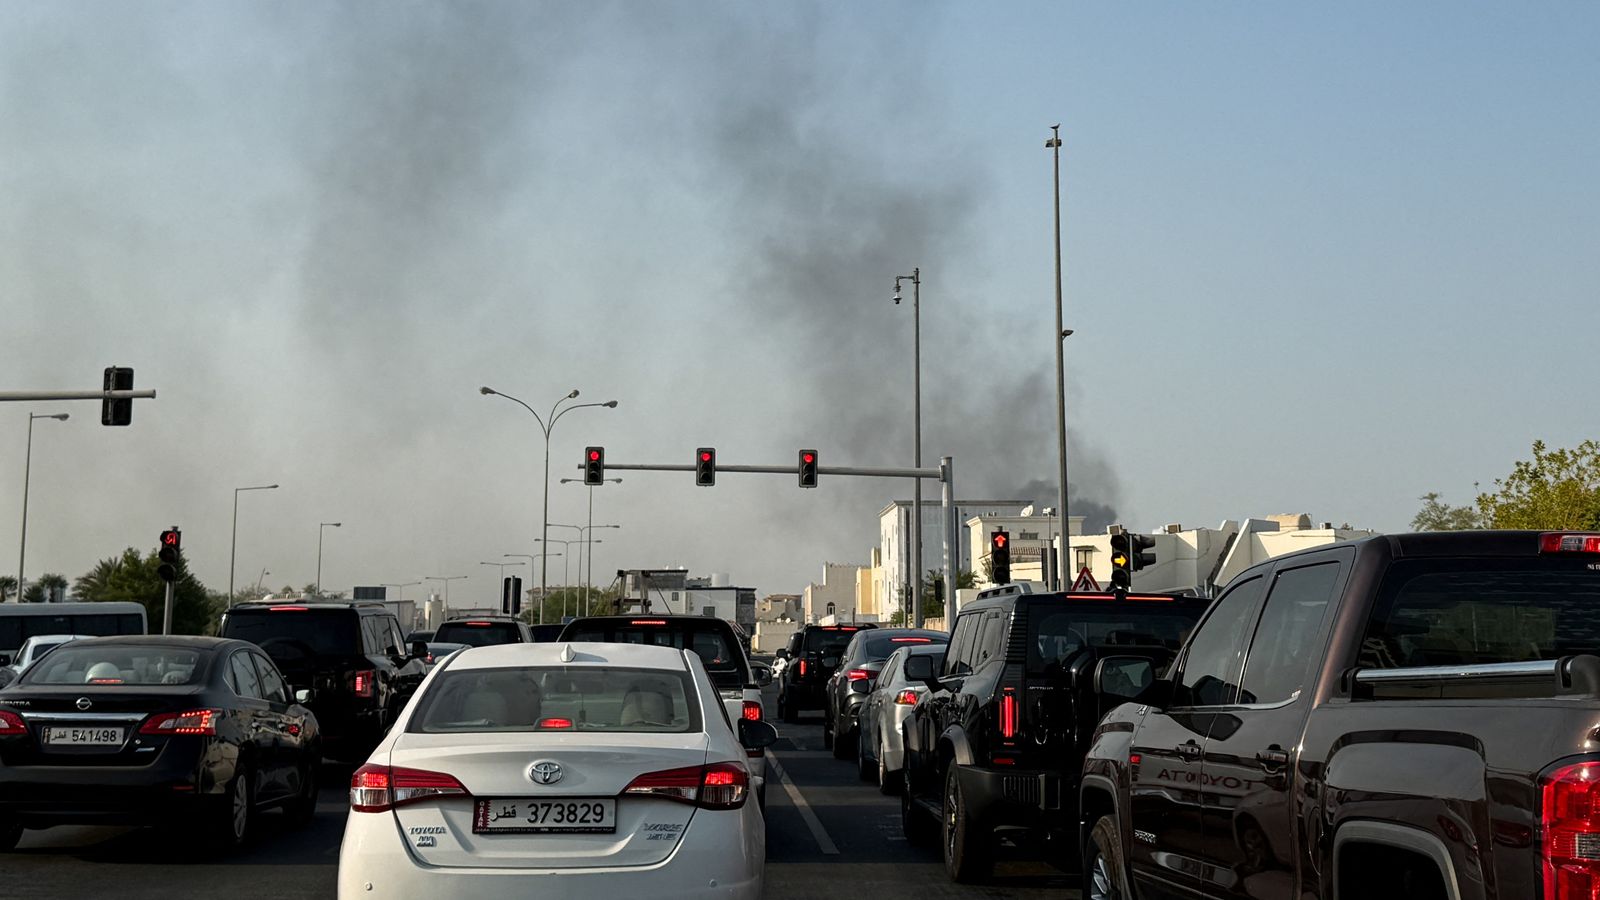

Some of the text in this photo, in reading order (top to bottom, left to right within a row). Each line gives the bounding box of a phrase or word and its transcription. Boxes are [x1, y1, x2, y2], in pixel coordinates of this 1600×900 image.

[72, 730, 117, 742] 541498
[491, 803, 605, 824] قطر 373829
[409, 826, 447, 835] TOYOTA
